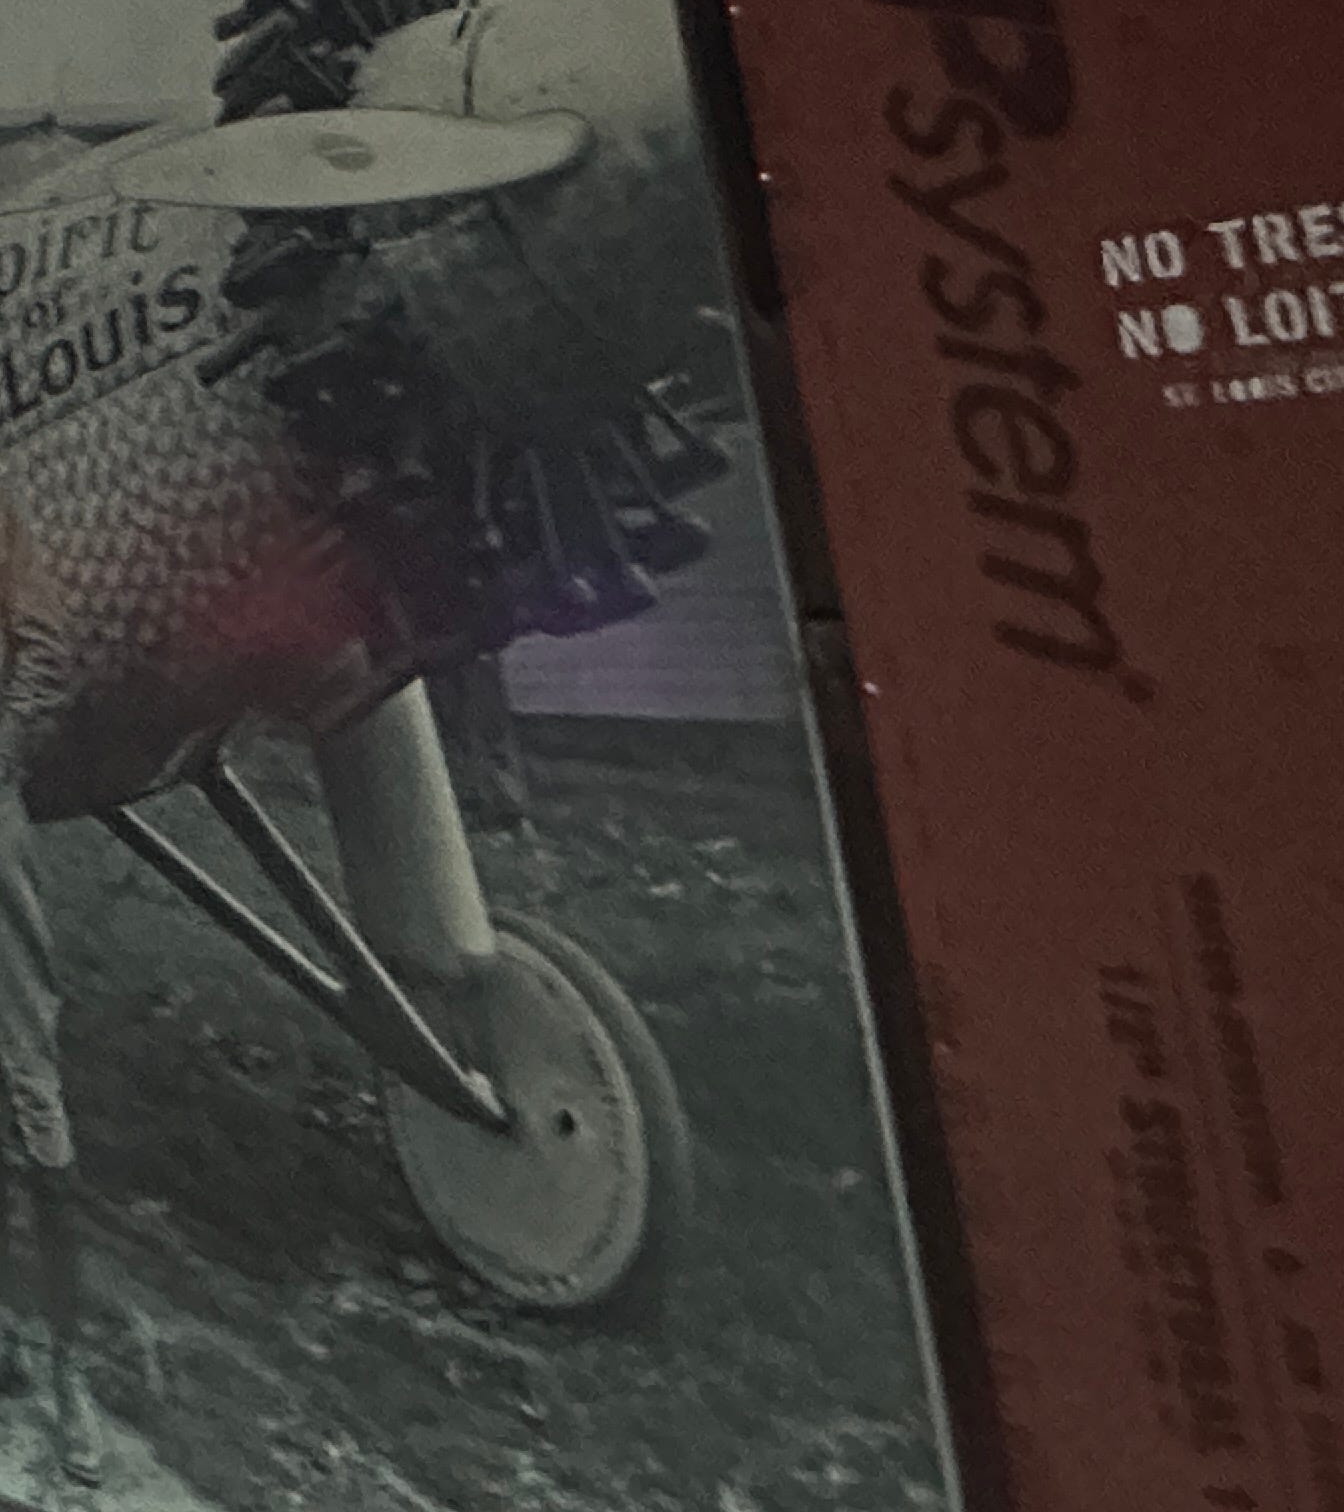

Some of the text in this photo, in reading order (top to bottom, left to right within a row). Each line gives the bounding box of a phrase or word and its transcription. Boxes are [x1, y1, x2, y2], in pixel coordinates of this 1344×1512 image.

[1101, 202, 1344, 287] NO TRE
[4, 264, 201, 419] Louis
[1223, 282, 1344, 346] LOI
